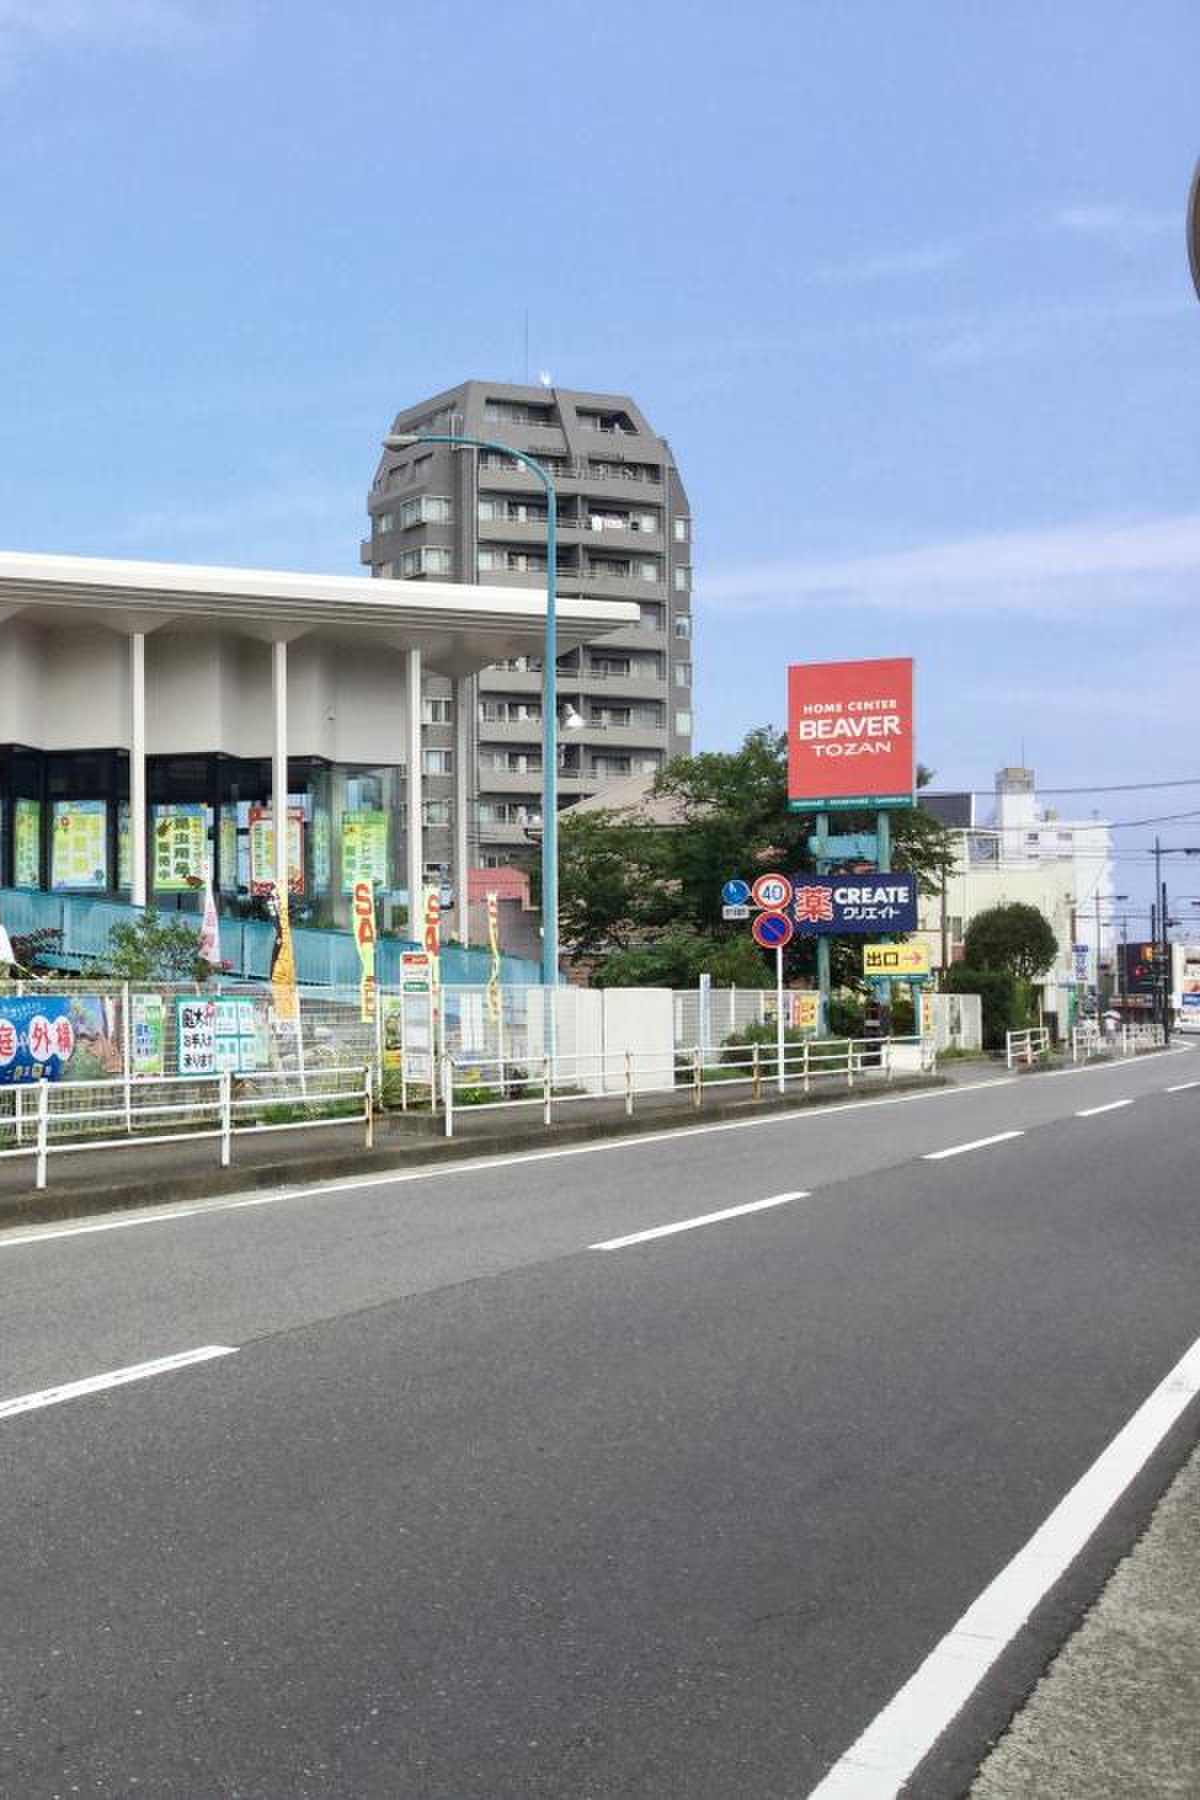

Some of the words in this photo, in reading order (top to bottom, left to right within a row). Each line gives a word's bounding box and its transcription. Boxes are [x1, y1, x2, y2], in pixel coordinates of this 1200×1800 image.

[803, 702, 843, 714] HOME
[847, 699, 897, 712] CENTER
[799, 714, 902, 741] BEAVER
[811, 740, 892, 758] TOZAN
[762, 885, 783, 901] 40
[794, 886, 834, 923] 薬
[834, 886, 910, 905] CREATE
[842, 906, 901, 921] クリエイト
[866, 949, 900, 968] 出口
